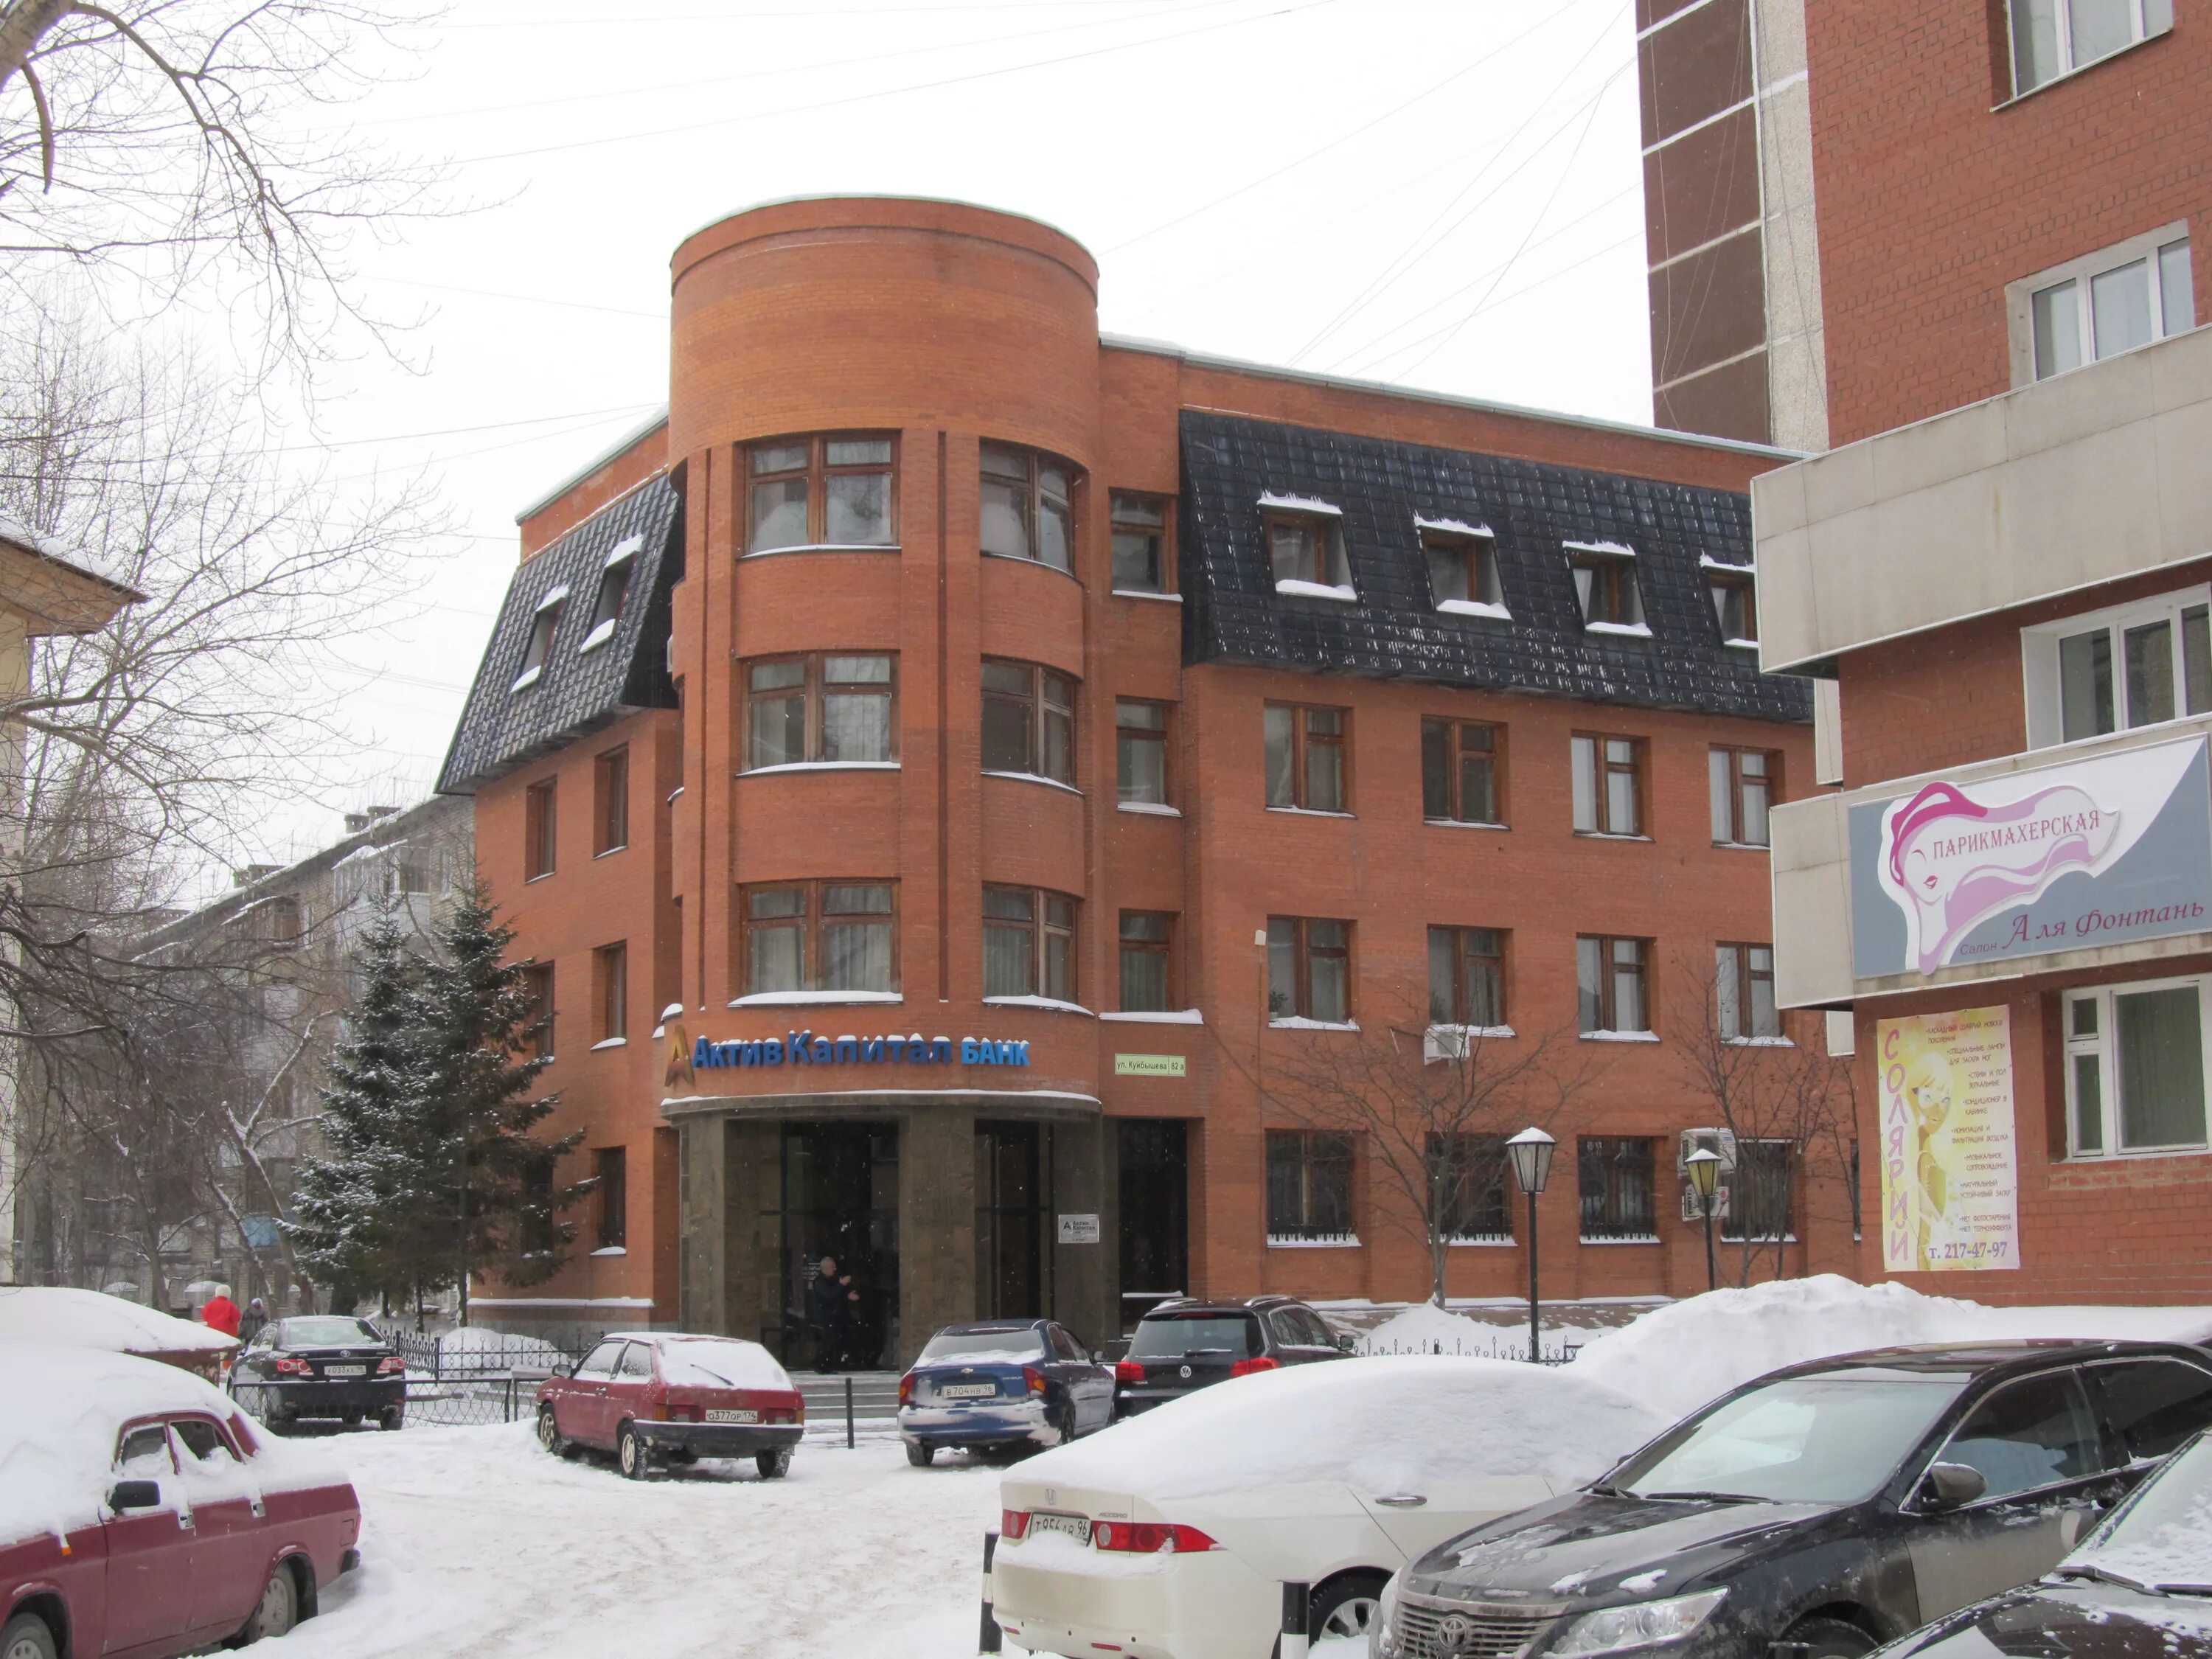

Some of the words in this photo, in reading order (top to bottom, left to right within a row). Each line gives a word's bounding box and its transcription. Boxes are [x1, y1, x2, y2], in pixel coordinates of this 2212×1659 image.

[1933, 810, 2100, 860] ПАРИКМАХЕРСКАЯ
[1960, 942, 1997, 956] Салон
[2076, 902, 2205, 937] Фонтань
[961, 1037, 1030, 1066] БАНК
[1950, 1057, 1960, 1065] ДЛЯ
[1963, 1055, 1980, 1063] ЗАГАРА
[1982, 1054, 1992, 1062] НОГ
[1128, 1060, 1167, 1071] Куйбышева
[1171, 1062, 1179, 1070] 82
[1944, 1241, 2008, 1259] 217-47-97
[1077, 1520, 1088, 1535] 96
